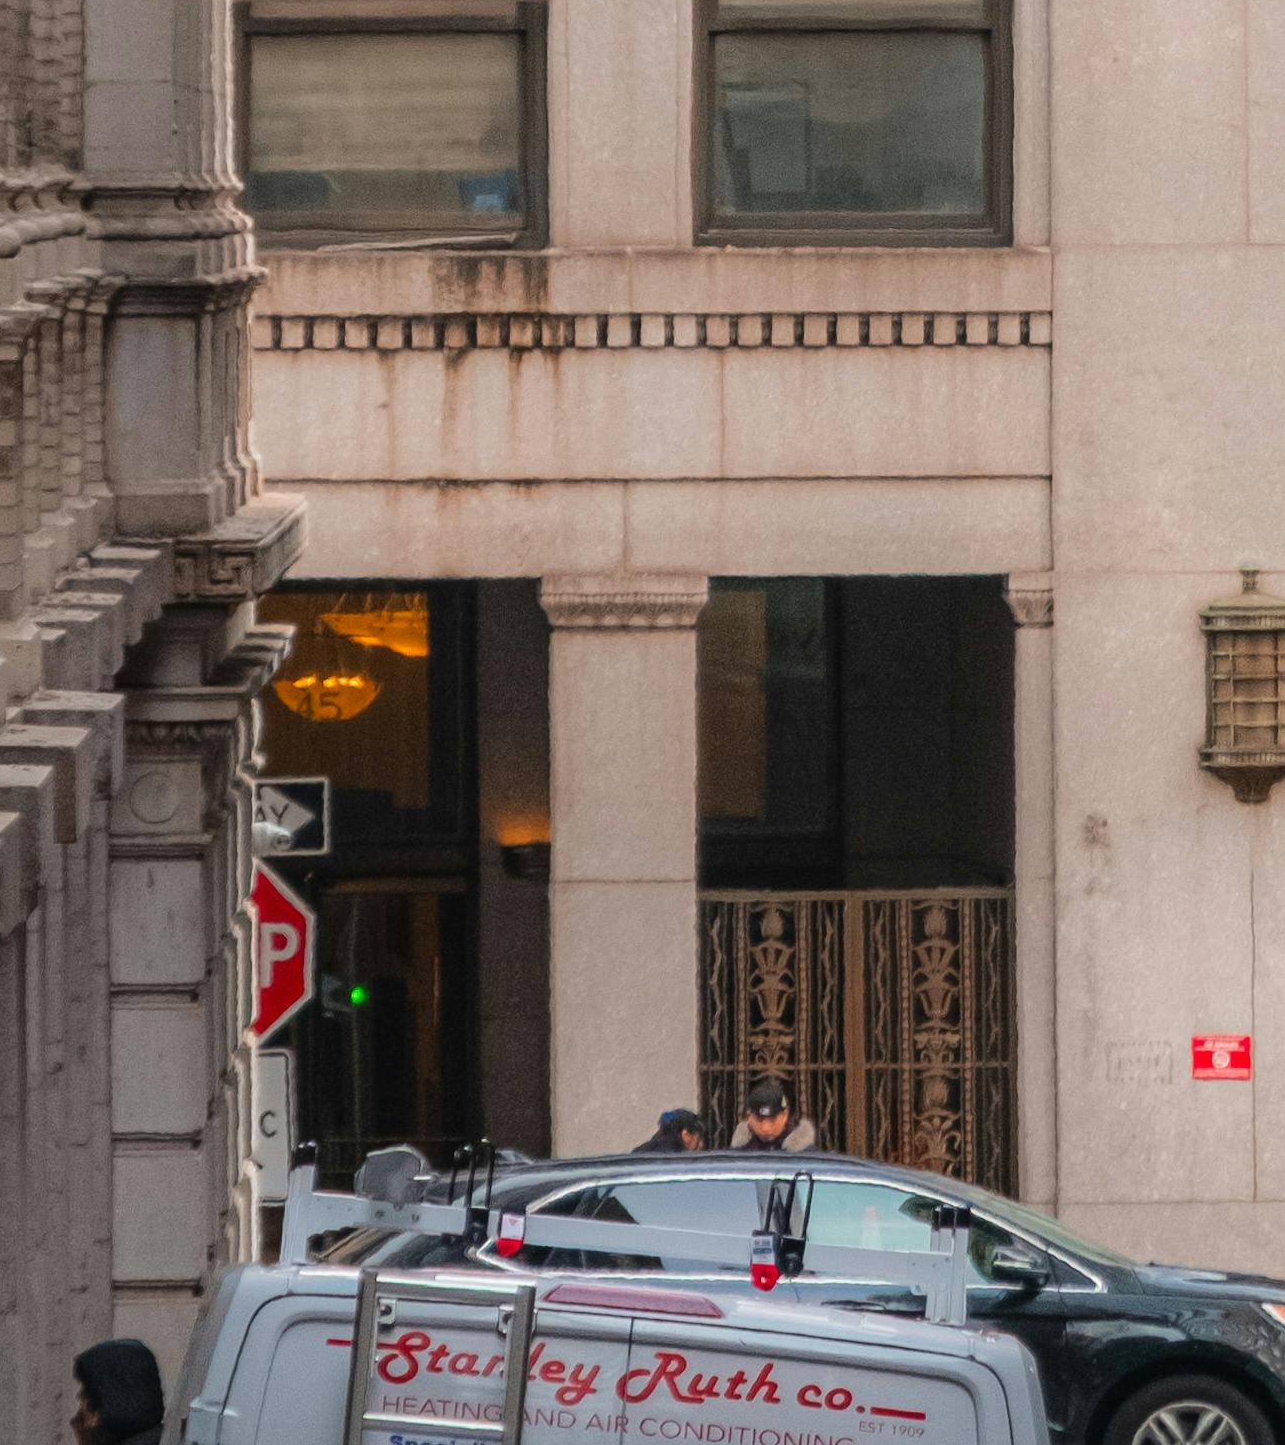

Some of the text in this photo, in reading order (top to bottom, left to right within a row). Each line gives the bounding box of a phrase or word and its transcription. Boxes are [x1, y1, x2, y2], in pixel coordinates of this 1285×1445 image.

[254, 803, 290, 824] AY
[616, 1351, 781, 1405] Ruth
[796, 1383, 866, 1414] co.
[381, 1394, 505, 1424] HEATING
[584, 1411, 629, 1434] AIR
[858, 1420, 926, 1439] EST 1909
